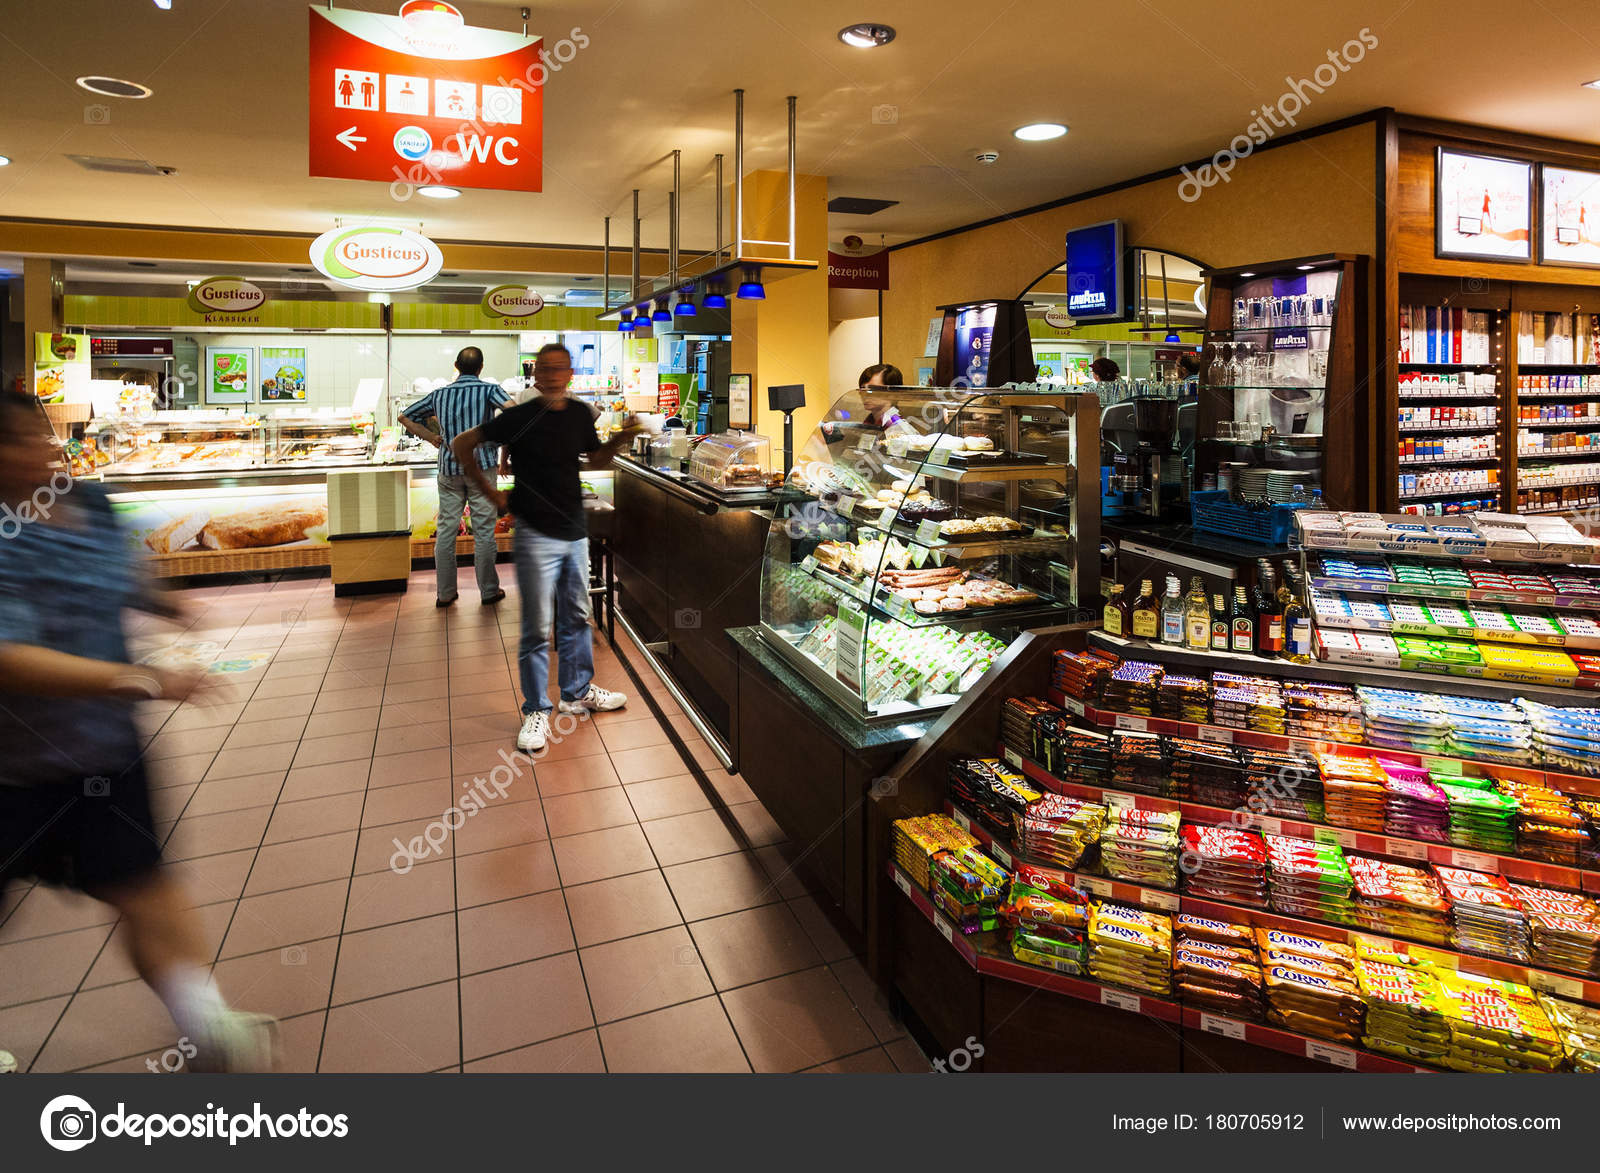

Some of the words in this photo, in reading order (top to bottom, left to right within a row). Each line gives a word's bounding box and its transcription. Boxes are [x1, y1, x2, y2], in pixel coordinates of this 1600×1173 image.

[457, 133, 519, 166] WC
[828, 265, 879, 279] Rezeption
[1069, 290, 1106, 305] LAVAZZA
[1275, 335, 1307, 345] LAVAZZA
[1487, 631, 1515, 639] Orbit
[1097, 922, 1143, 938] CORNY
[1178, 914, 1231, 930] CORNY
[1268, 931, 1324, 949] CORNY
[1177, 950, 1231, 969] CORNY
[1268, 950, 1323, 967] CORNY
[1271, 967, 1330, 987] CORNY
